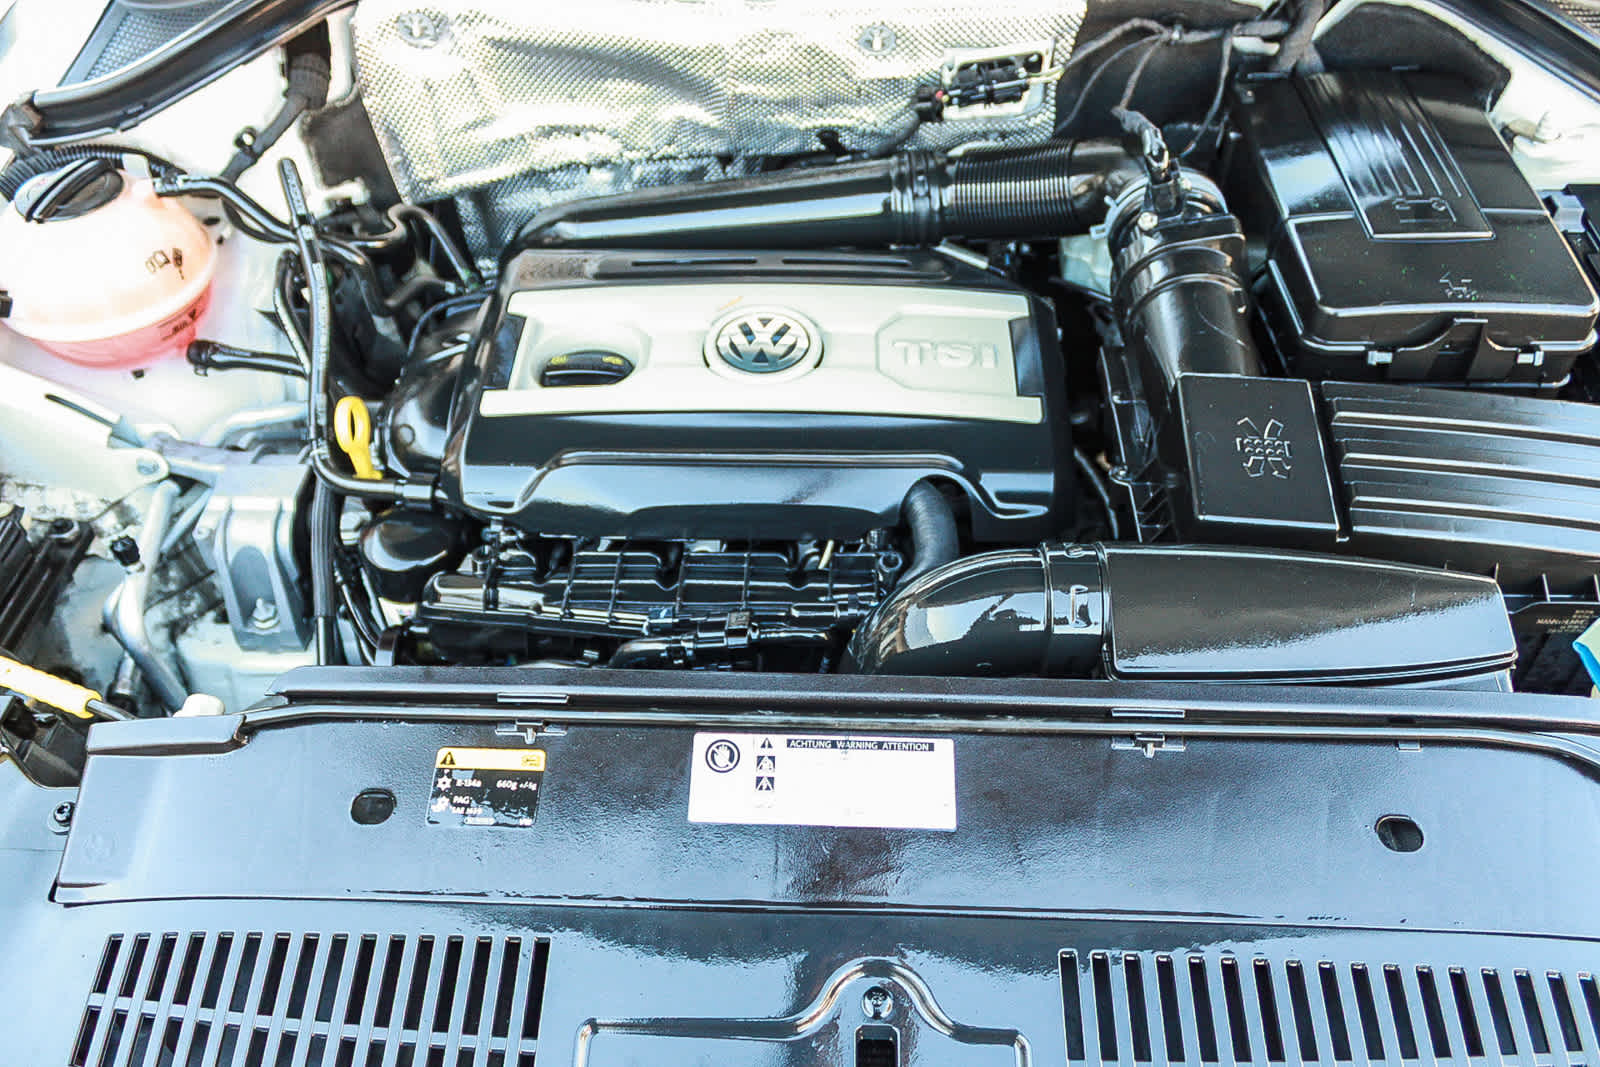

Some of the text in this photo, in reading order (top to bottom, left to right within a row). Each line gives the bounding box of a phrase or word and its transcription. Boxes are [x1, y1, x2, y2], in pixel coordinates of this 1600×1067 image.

[893, 340, 998, 369] TSI
[790, 739, 929, 752] ACHTUNG WARNING ATTENTION
